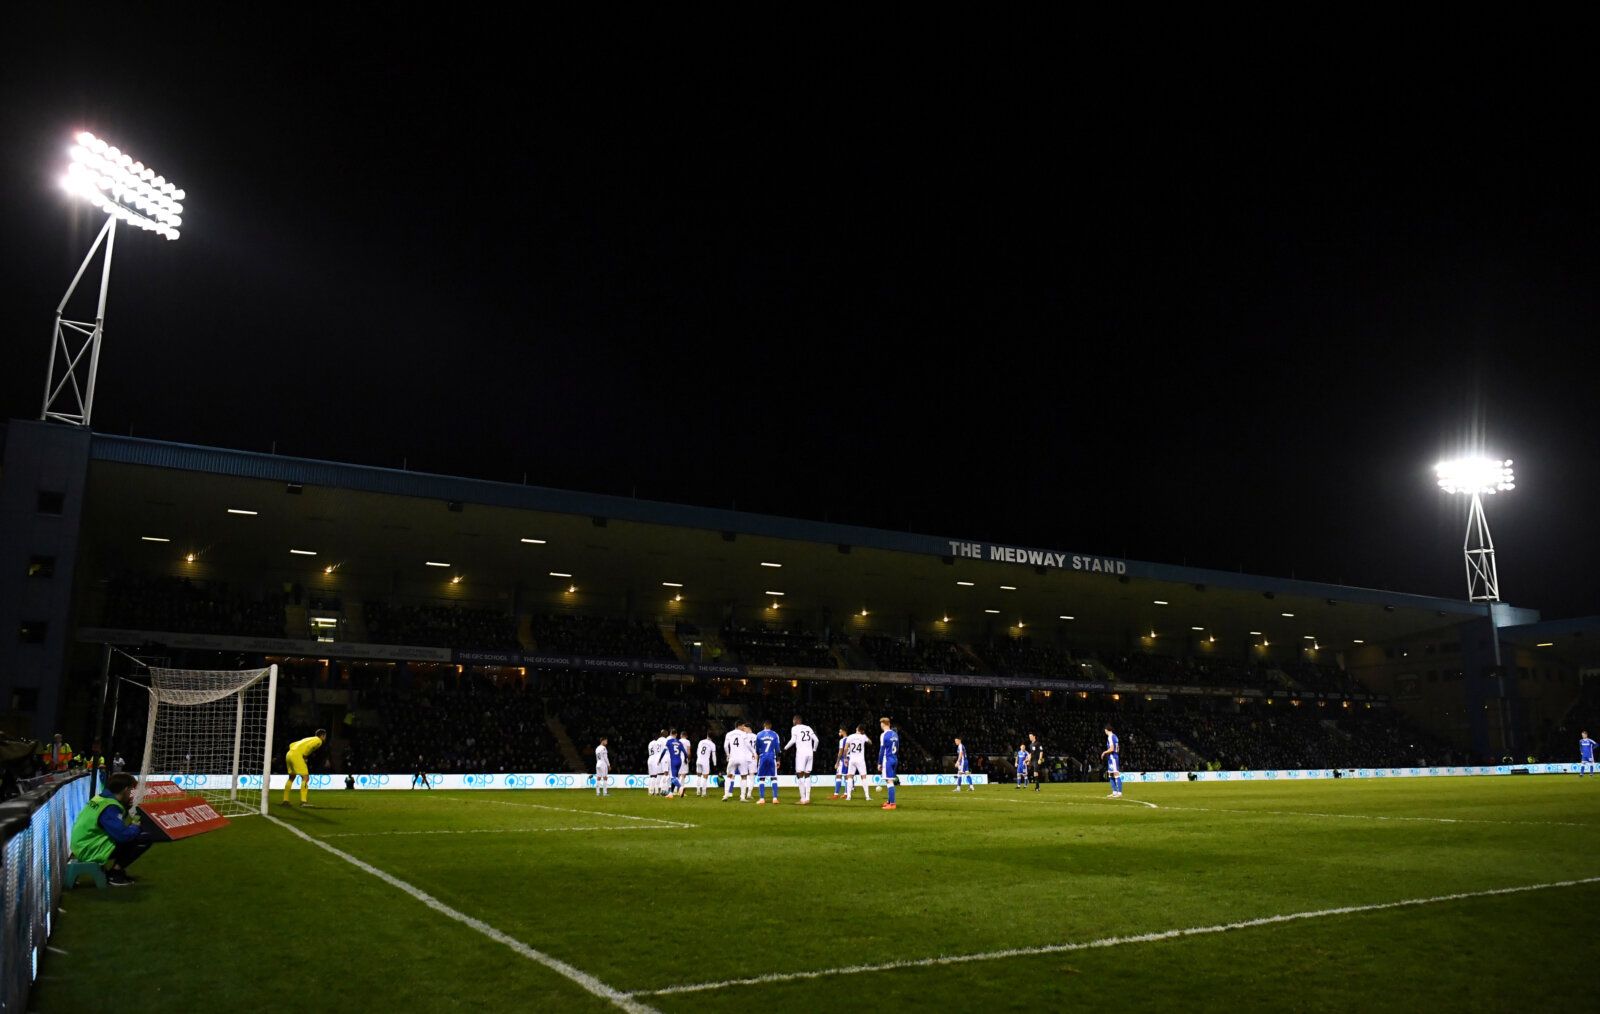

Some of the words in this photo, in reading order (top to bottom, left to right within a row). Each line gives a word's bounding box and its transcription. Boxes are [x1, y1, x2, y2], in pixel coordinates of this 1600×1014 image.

[949, 541, 981, 559] THE
[990, 546, 1066, 568] MEDWAY
[1072, 556, 1126, 575] STAND
[800, 730, 811, 741] 23
[732, 737, 740, 747] 4
[763, 741, 772, 752] 7
[673, 745, 680, 755] 5
[700, 746, 707, 755] 8
[850, 743, 862, 753] 24
